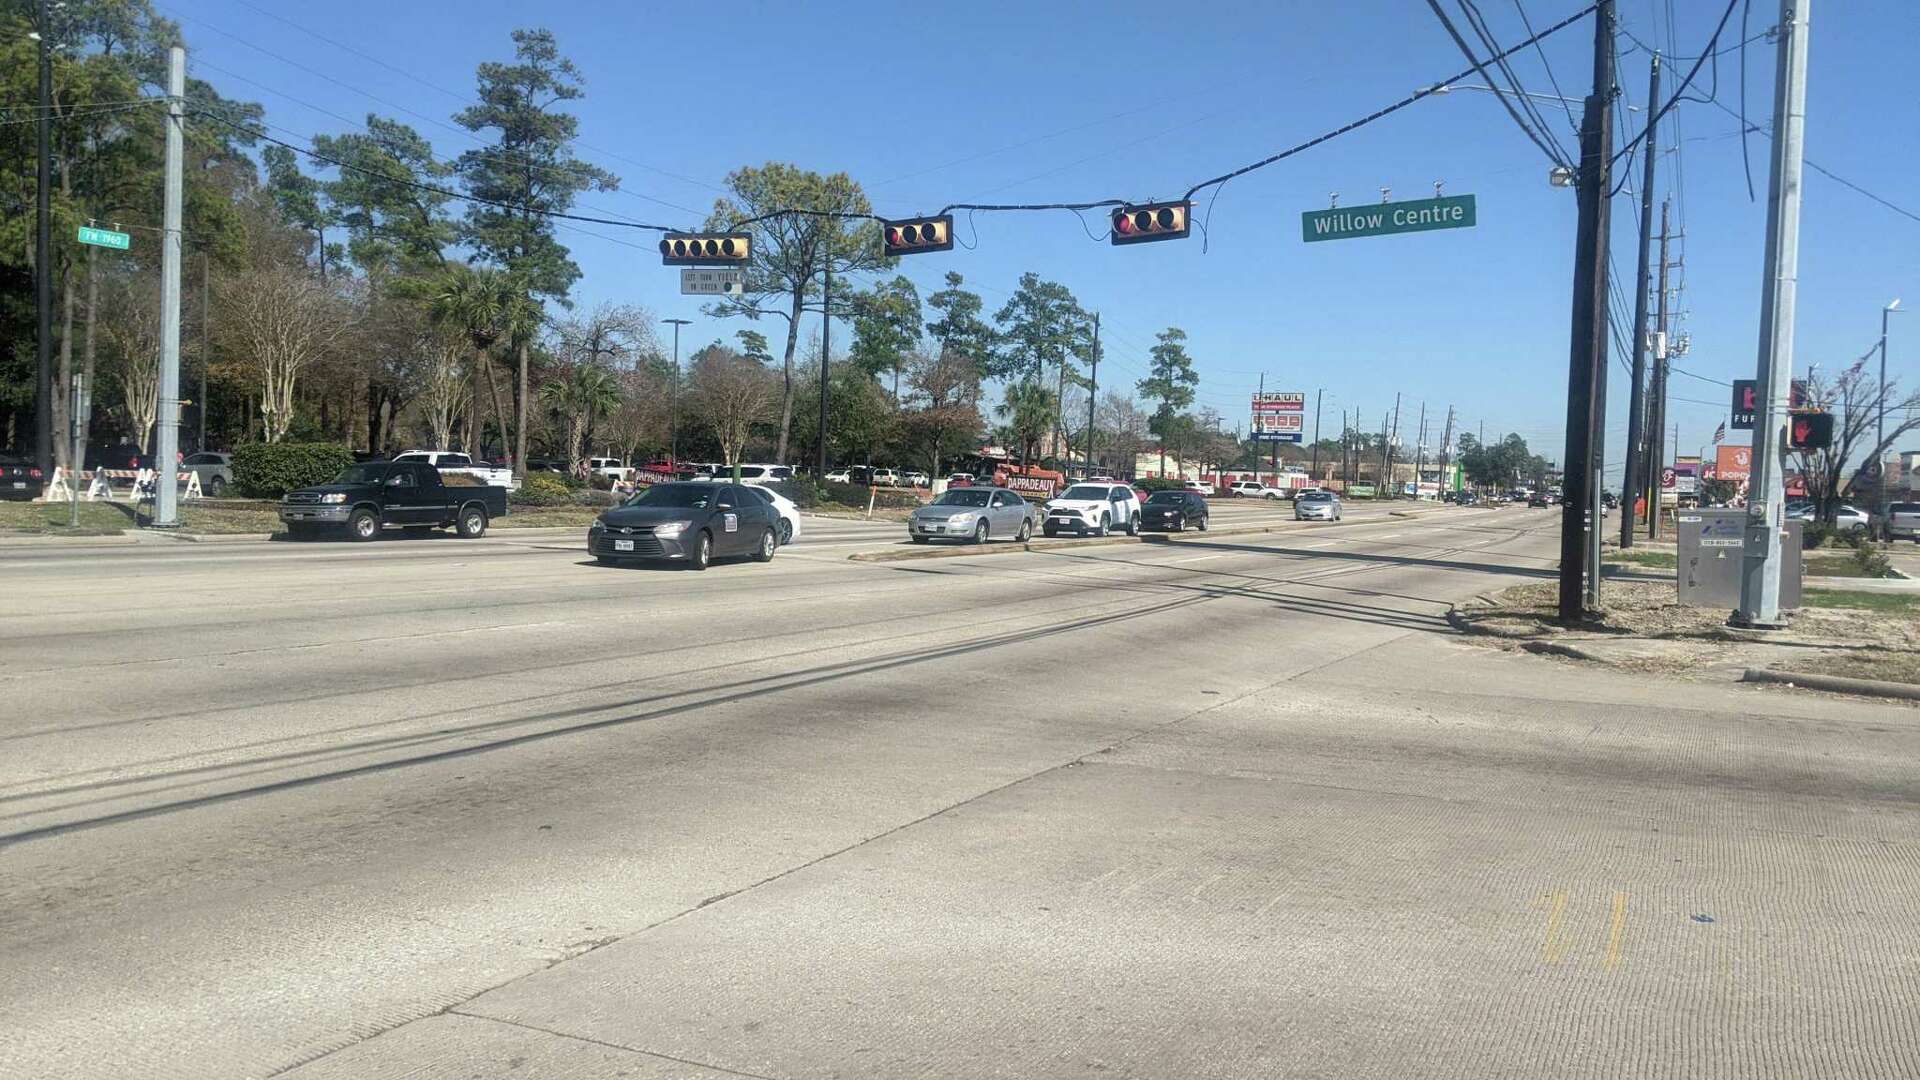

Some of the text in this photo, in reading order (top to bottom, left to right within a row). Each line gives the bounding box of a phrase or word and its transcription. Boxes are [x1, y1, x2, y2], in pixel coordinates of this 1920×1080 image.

[1314, 205, 1464, 234] Willow Centre
[86, 230, 121, 246] FM 1960
[1007, 477, 1056, 499] PAPPADEAUX
